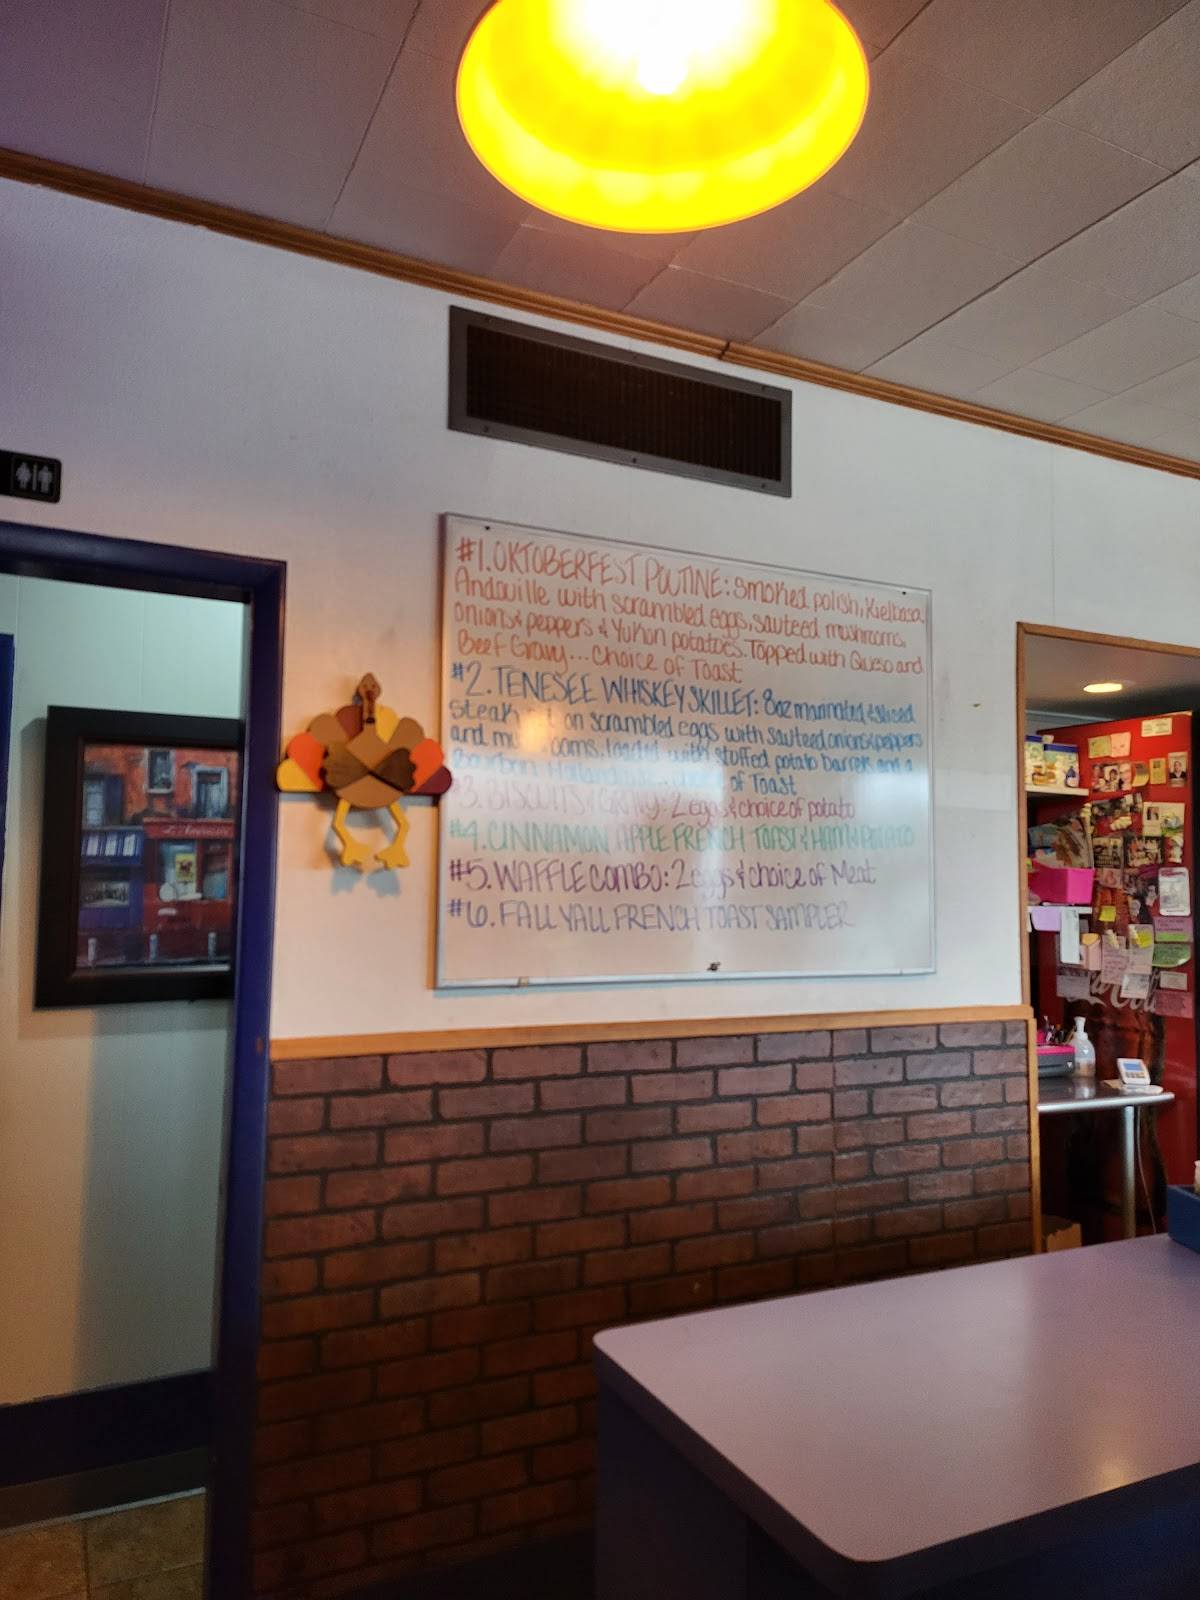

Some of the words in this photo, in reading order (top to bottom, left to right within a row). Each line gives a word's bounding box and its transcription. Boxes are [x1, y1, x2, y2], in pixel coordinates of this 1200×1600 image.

[455, 566, 550, 606] Andouille
[558, 586, 606, 612] with
[611, 593, 705, 627] scrambled
[752, 613, 820, 640] sauteed
[457, 628, 507, 657] Beef
[663, 655, 685, 677] of
[688, 658, 742, 684] Toast
[809, 650, 846, 669] with
[849, 650, 893, 674] Queso
[896, 656, 924, 675] and
[491, 665, 598, 705] TENESEE
[600, 674, 685, 714] WHISKEY
[590, 711, 673, 738] scrambled
[678, 720, 719, 743] eggs
[724, 723, 764, 745] with
[450, 723, 488, 747] and
[775, 751, 818, 775] potato
[751, 773, 797, 796] Toast
[738, 796, 788, 819] choice
[808, 797, 854, 823] potato
[488, 820, 610, 854] CINNAMON
[672, 821, 746, 852] FRENCH
[493, 858, 586, 893] WAFFLE
[671, 858, 690, 890] 2
[748, 859, 806, 889] choice
[808, 862, 826, 886] of
[830, 859, 877, 886] Meat
[499, 900, 557, 931] FALL
[559, 902, 610, 933] YALL
[614, 903, 701, 932] FRENCH
[704, 904, 763, 930] TOAST
[766, 901, 856, 932] SAMPLER
